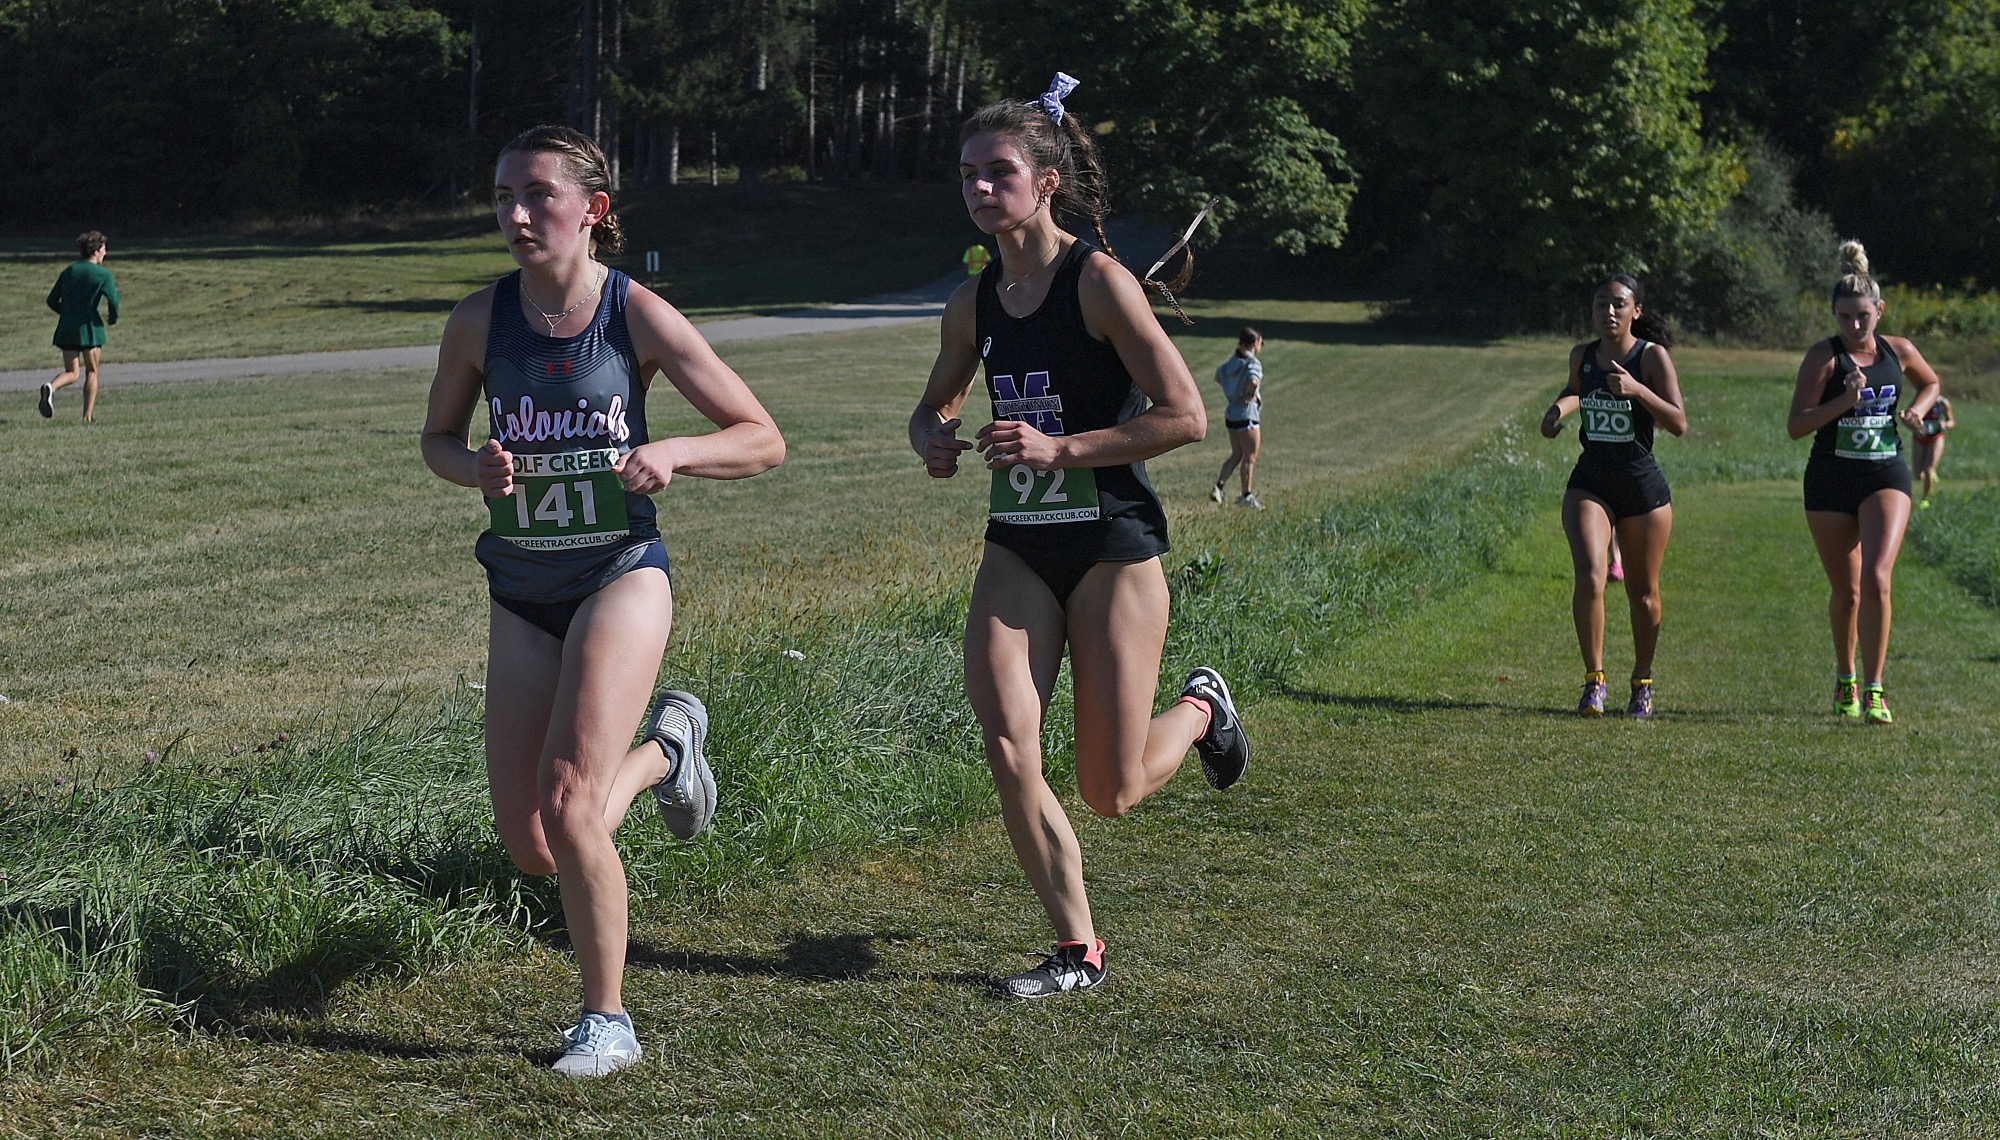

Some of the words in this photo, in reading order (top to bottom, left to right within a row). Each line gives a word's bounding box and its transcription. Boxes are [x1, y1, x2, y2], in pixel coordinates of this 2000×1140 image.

[993, 371, 1064, 434] M
[1581, 399, 1603, 408] WOLF
[492, 395, 630, 444] Colonials
[1586, 410, 1631, 433] 120
[1851, 429, 1883, 450] 97
[512, 455, 543, 474] OLF
[548, 450, 614, 473] CREEK
[1008, 463, 1068, 505] 92
[511, 479, 597, 529] 141
